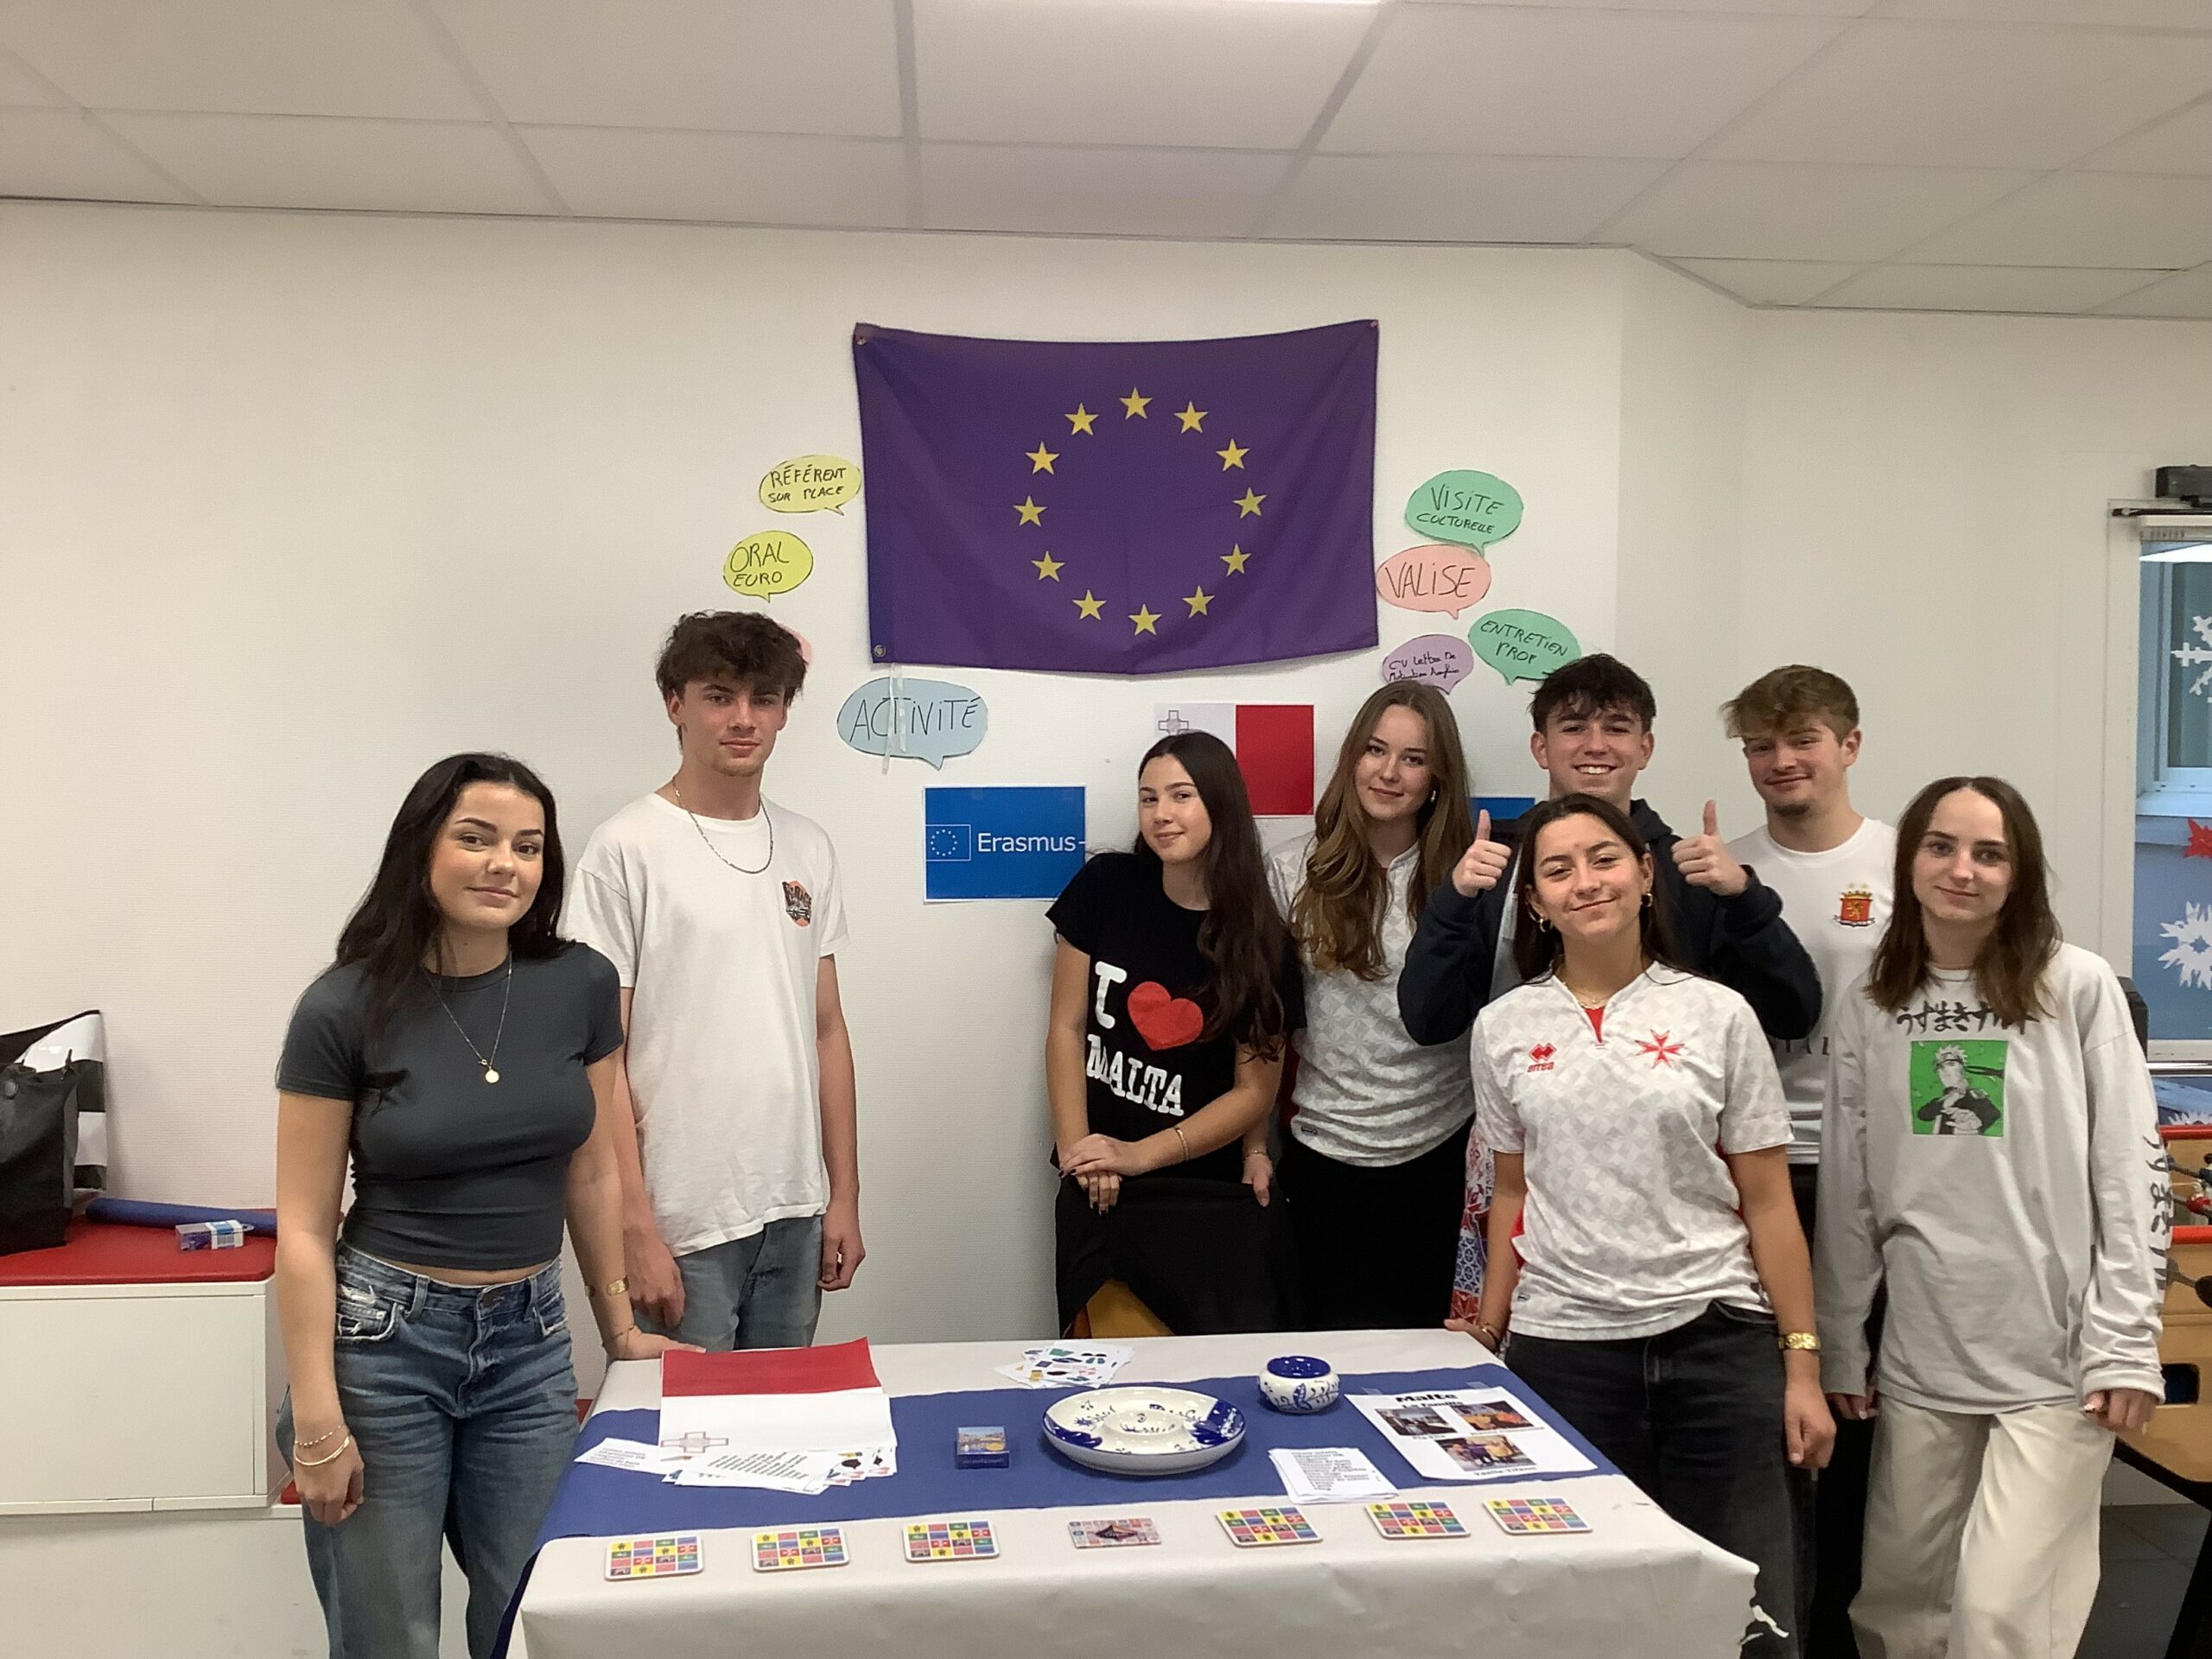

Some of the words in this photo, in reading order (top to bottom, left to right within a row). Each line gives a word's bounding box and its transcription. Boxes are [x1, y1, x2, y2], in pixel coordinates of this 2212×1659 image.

[771, 464, 847, 488] RÉFÉRENT
[768, 493, 791, 503] SUR
[804, 486, 844, 499] PLACE
[1431, 484, 1503, 515] VISITE
[1416, 513, 1496, 534] CULTURELLE
[730, 541, 790, 572] ORAL
[734, 571, 783, 588] EURO
[1385, 562, 1475, 599] VALISE
[1480, 620, 1567, 657] ENTRETIEN
[1389, 660, 1408, 670] CV
[849, 696, 982, 742] ACTIVITÉ
[1095, 961, 1127, 1029] I
[1087, 1033, 1184, 1116] MALTA
[1395, 1393, 1458, 1403] Malte
